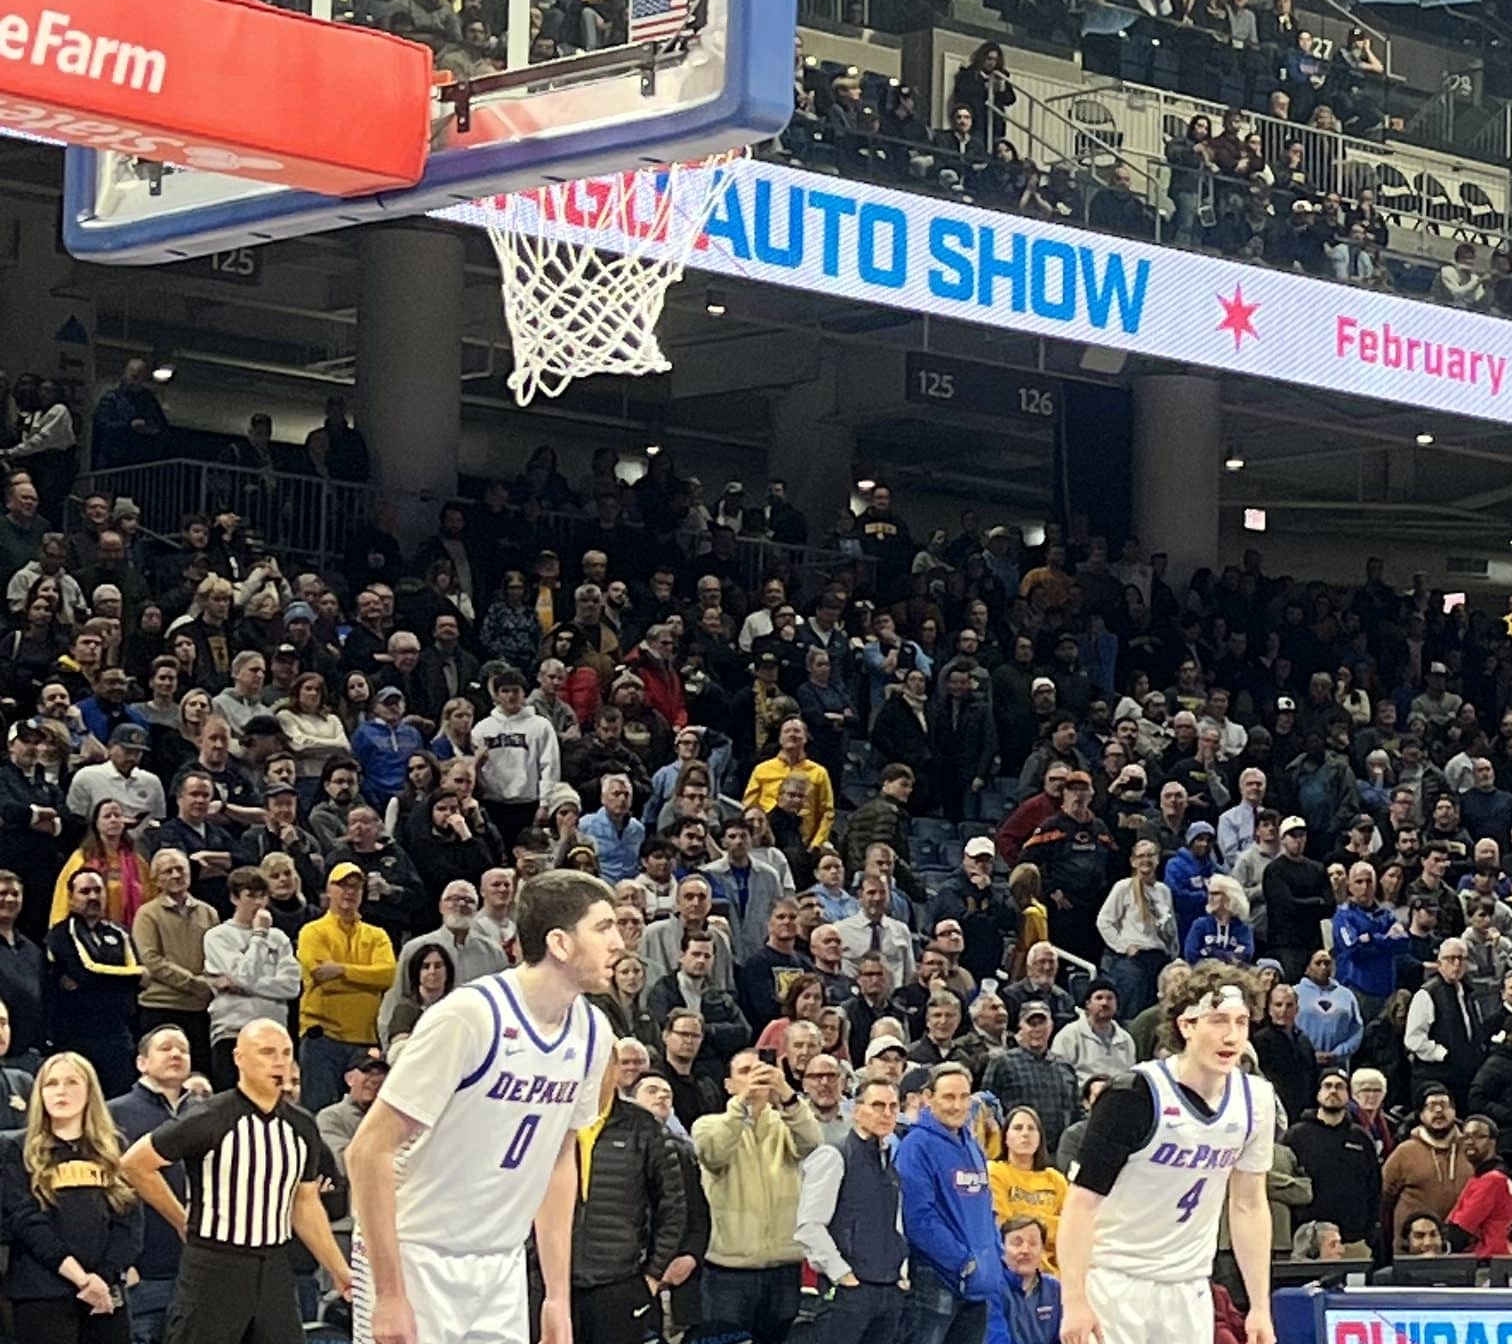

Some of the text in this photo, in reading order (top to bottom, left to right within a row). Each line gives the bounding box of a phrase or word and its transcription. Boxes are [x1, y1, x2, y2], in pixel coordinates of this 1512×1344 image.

[704, 168, 908, 289] AUTO
[927, 216, 1152, 335] SHOW
[1336, 314, 1507, 397] February
[918, 369, 1054, 416] 125 126
[500, 1114, 543, 1169] 0
[1176, 1176, 1209, 1224] 4
